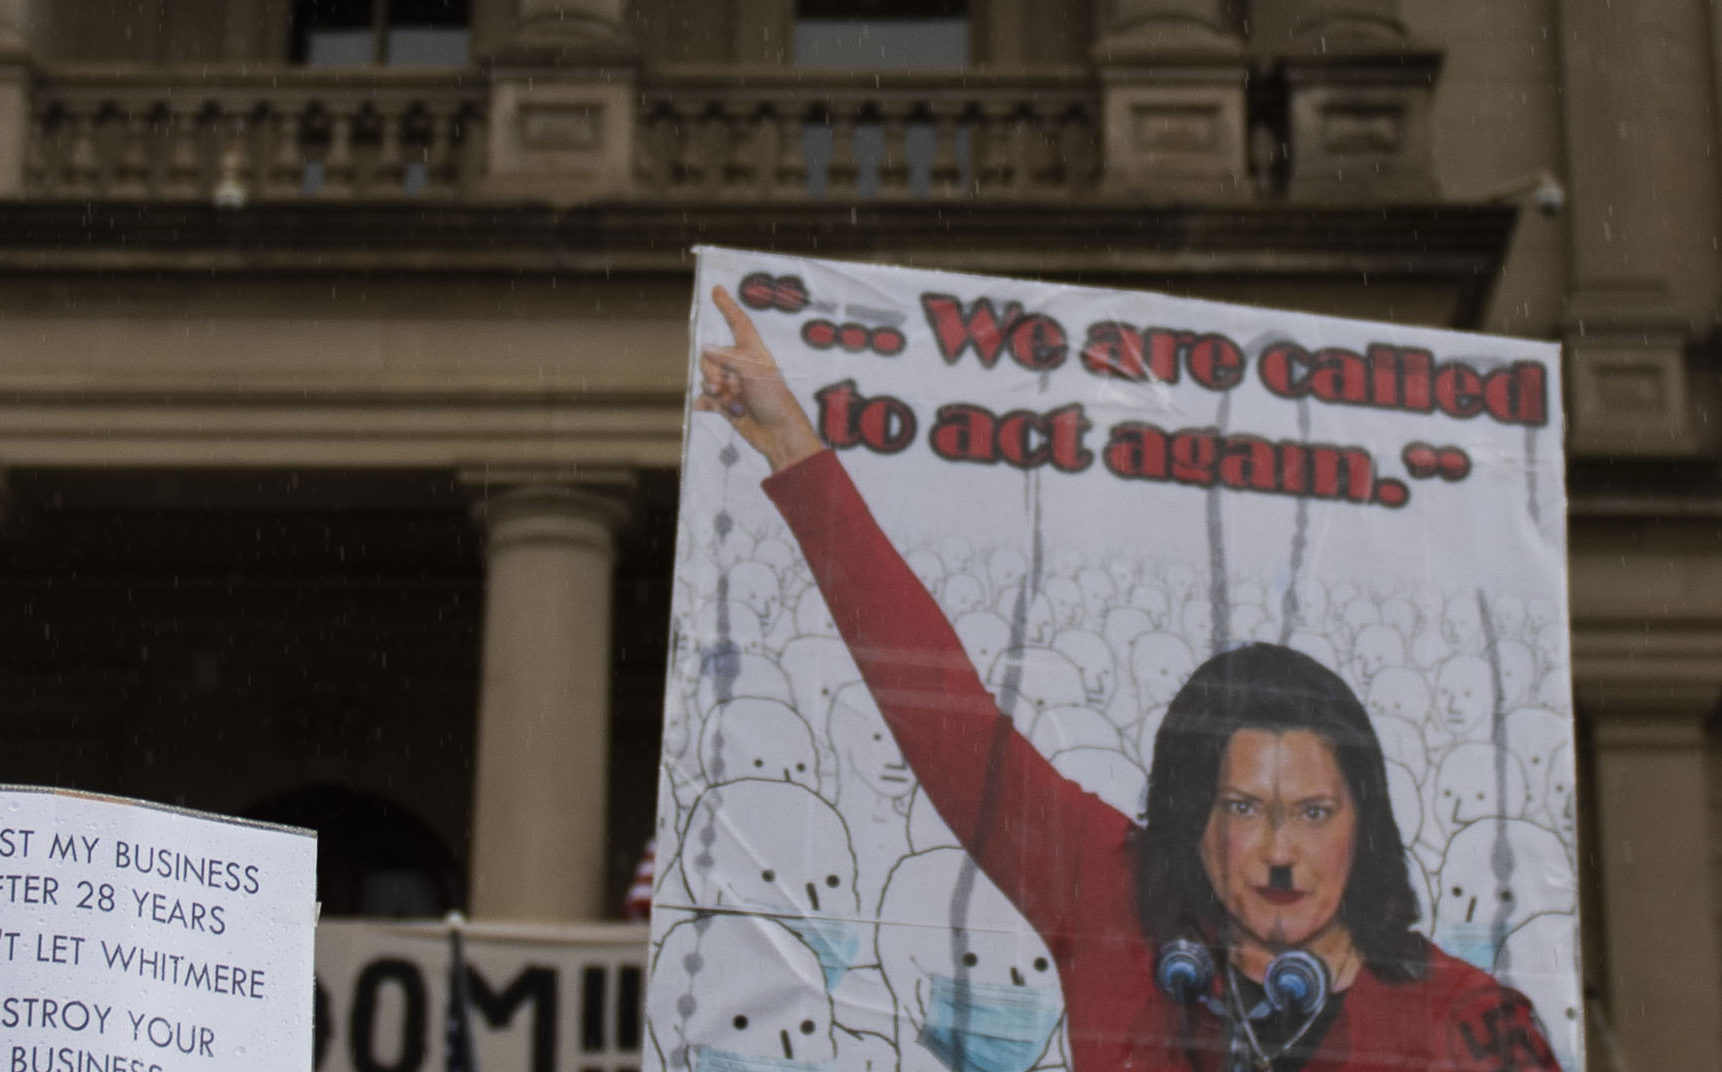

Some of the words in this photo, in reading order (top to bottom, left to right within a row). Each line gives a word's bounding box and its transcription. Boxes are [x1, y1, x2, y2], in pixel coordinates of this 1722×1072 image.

[920, 292, 1069, 370] We
[1080, 319, 1247, 392] are
[1257, 339, 1548, 428] called
[814, 378, 918, 455] to
[929, 402, 1095, 474] act
[49, 832, 101, 865] MY
[115, 840, 261, 896] BUSINESS
[76, 880, 116, 914] 28
[131, 889, 227, 937] YEARS
[35, 933, 87, 966] LET
[100, 940, 267, 1001] WHITMERE
[127, 1011, 216, 1059] YOUR
